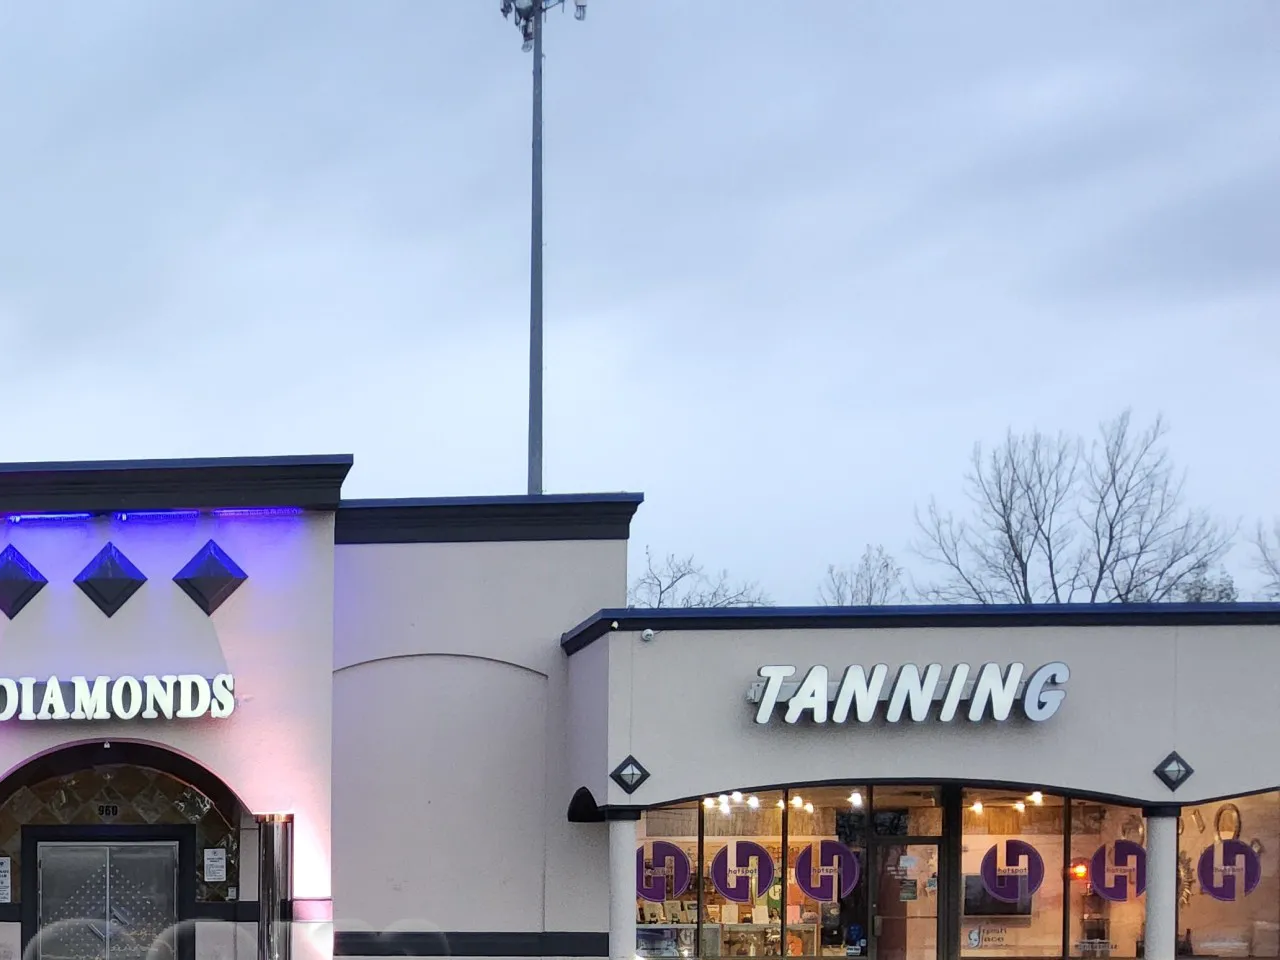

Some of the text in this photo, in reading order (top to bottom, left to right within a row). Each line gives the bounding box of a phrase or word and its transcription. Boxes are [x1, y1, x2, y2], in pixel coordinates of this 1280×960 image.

[755, 662, 1070, 724] TANNING
[98, 805, 118, 816] 960
[728, 867, 758, 876] hotspot
[812, 867, 841, 876] hotsp
[997, 867, 1027, 875] hotspot
